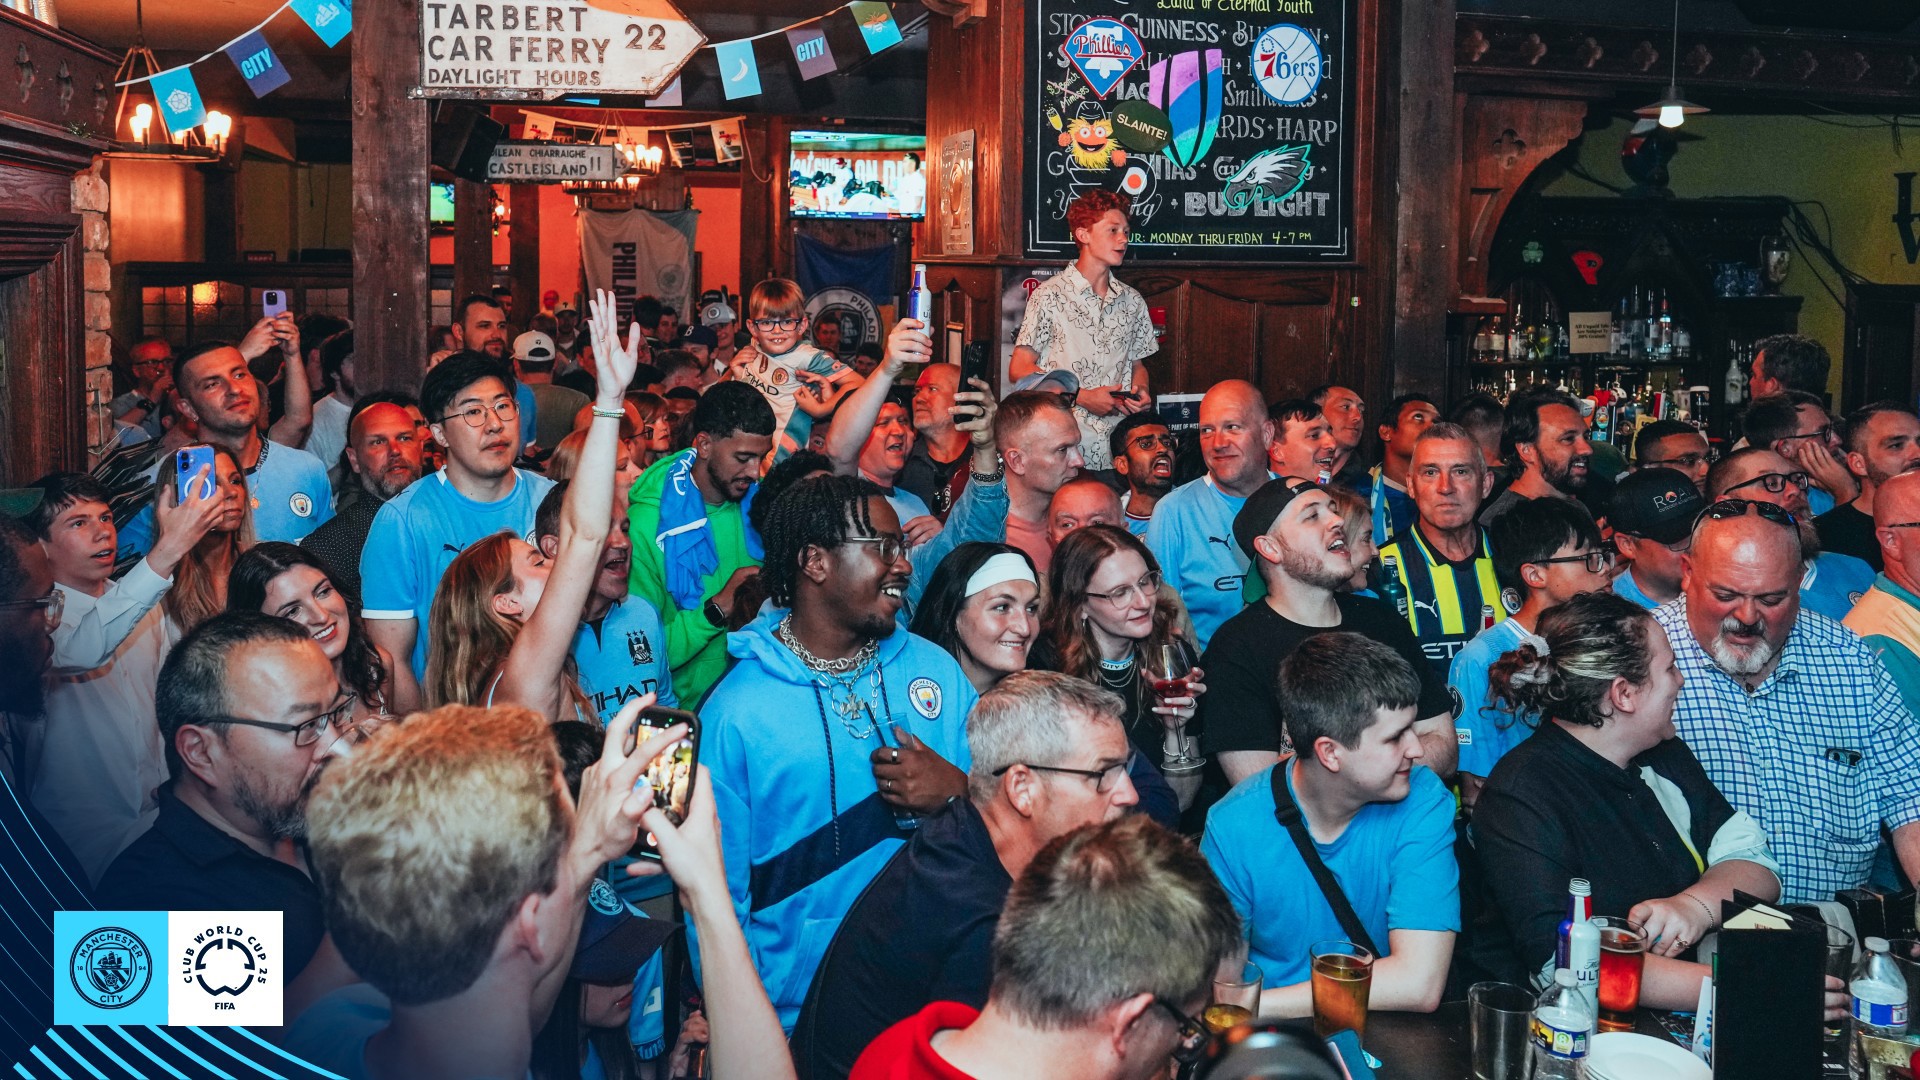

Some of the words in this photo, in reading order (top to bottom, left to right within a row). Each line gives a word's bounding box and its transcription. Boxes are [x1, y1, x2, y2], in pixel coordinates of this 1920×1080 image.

[427, 3, 588, 32] TARBERT
[428, 35, 494, 61] CAR
[509, 36, 611, 63] FERRY
[624, 23, 666, 51] 22
[796, 36, 825, 62] CITY
[1073, 34, 1131, 56] Phillies
[241, 47, 273, 80] CITY
[1260, 52, 1316, 79] 76ers
[428, 68, 521, 85] DAYLIGHT
[536, 70, 601, 86] HOURS
[1116, 113, 1168, 140] SLAINTE!
[1276, 118, 1338, 146] HARP
[529, 149, 586, 158] CHIARRAIGHE
[489, 163, 588, 176] CASTLEISLAND
[1150, 233, 1194, 244] MONDAY
[1199, 233, 1225, 245] THRU
[1228, 233, 1263, 245] FRIDAY
[1299, 232, 1312, 241] PM
[1102, 662, 1120, 670] CITY
